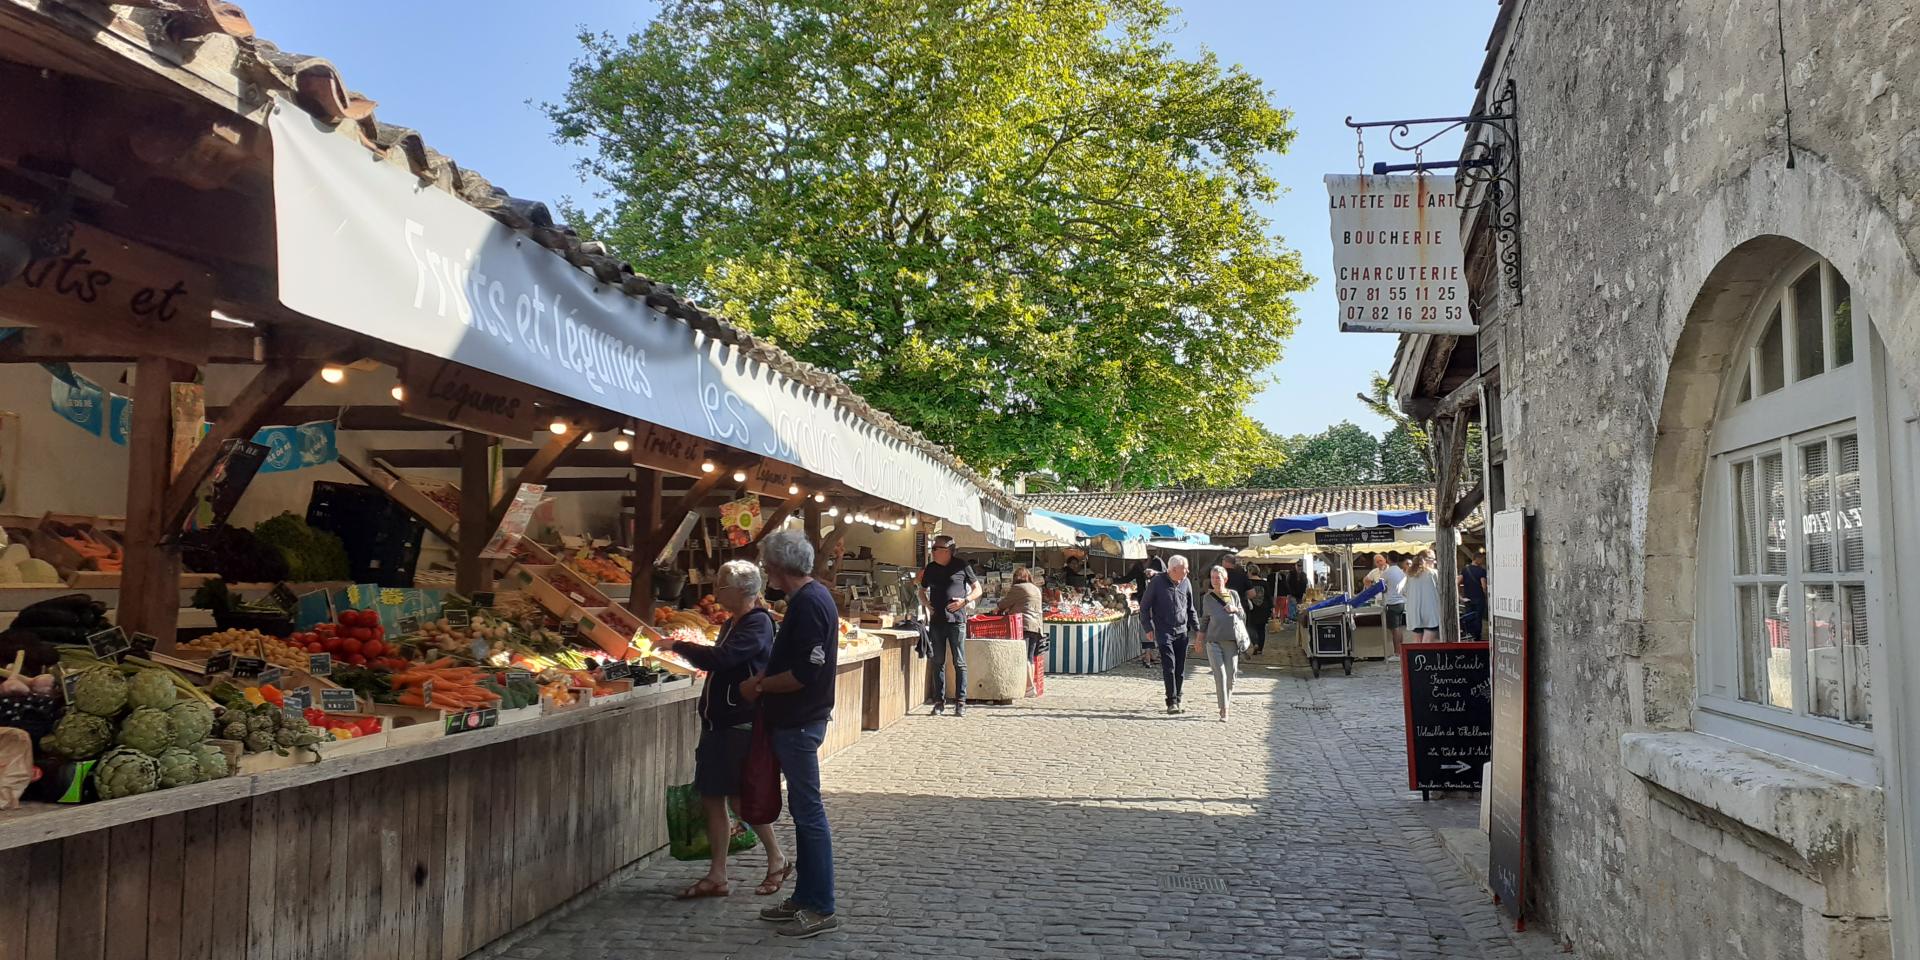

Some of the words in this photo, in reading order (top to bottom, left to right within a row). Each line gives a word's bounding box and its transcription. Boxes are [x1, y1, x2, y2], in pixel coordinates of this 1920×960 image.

[1331, 195, 1346, 208] LA
[1351, 194, 1384, 208] TETE
[1394, 194, 1409, 207] DE
[1417, 192, 1455, 208] L'ART
[1343, 231, 1442, 245] BOUCHERIE
[1340, 266, 1458, 280] CHARCUTERIE
[1340, 287, 1357, 301] 07
[1367, 287, 1380, 301] 81
[1389, 287, 1407, 300] 55
[1416, 287, 1429, 300] 11
[1438, 286, 1455, 300] 25
[130, 281, 188, 322] et
[405, 218, 512, 343] Fruits
[516, 284, 550, 361] et
[553, 294, 653, 398] Légumes
[1347, 306, 1364, 320] 07
[1372, 306, 1389, 320] 82
[1397, 306, 1412, 320] 16
[1421, 306, 1437, 320] 23
[1445, 306, 1462, 320] 53
[427, 361, 521, 421] Légumes
[763, 383, 843, 476] Jardins
[1414, 653, 1454, 671] Poulets
[1430, 673, 1468, 685] Fermier
[1432, 686, 1461, 698] Entier
[1441, 700, 1466, 712] Poulet
